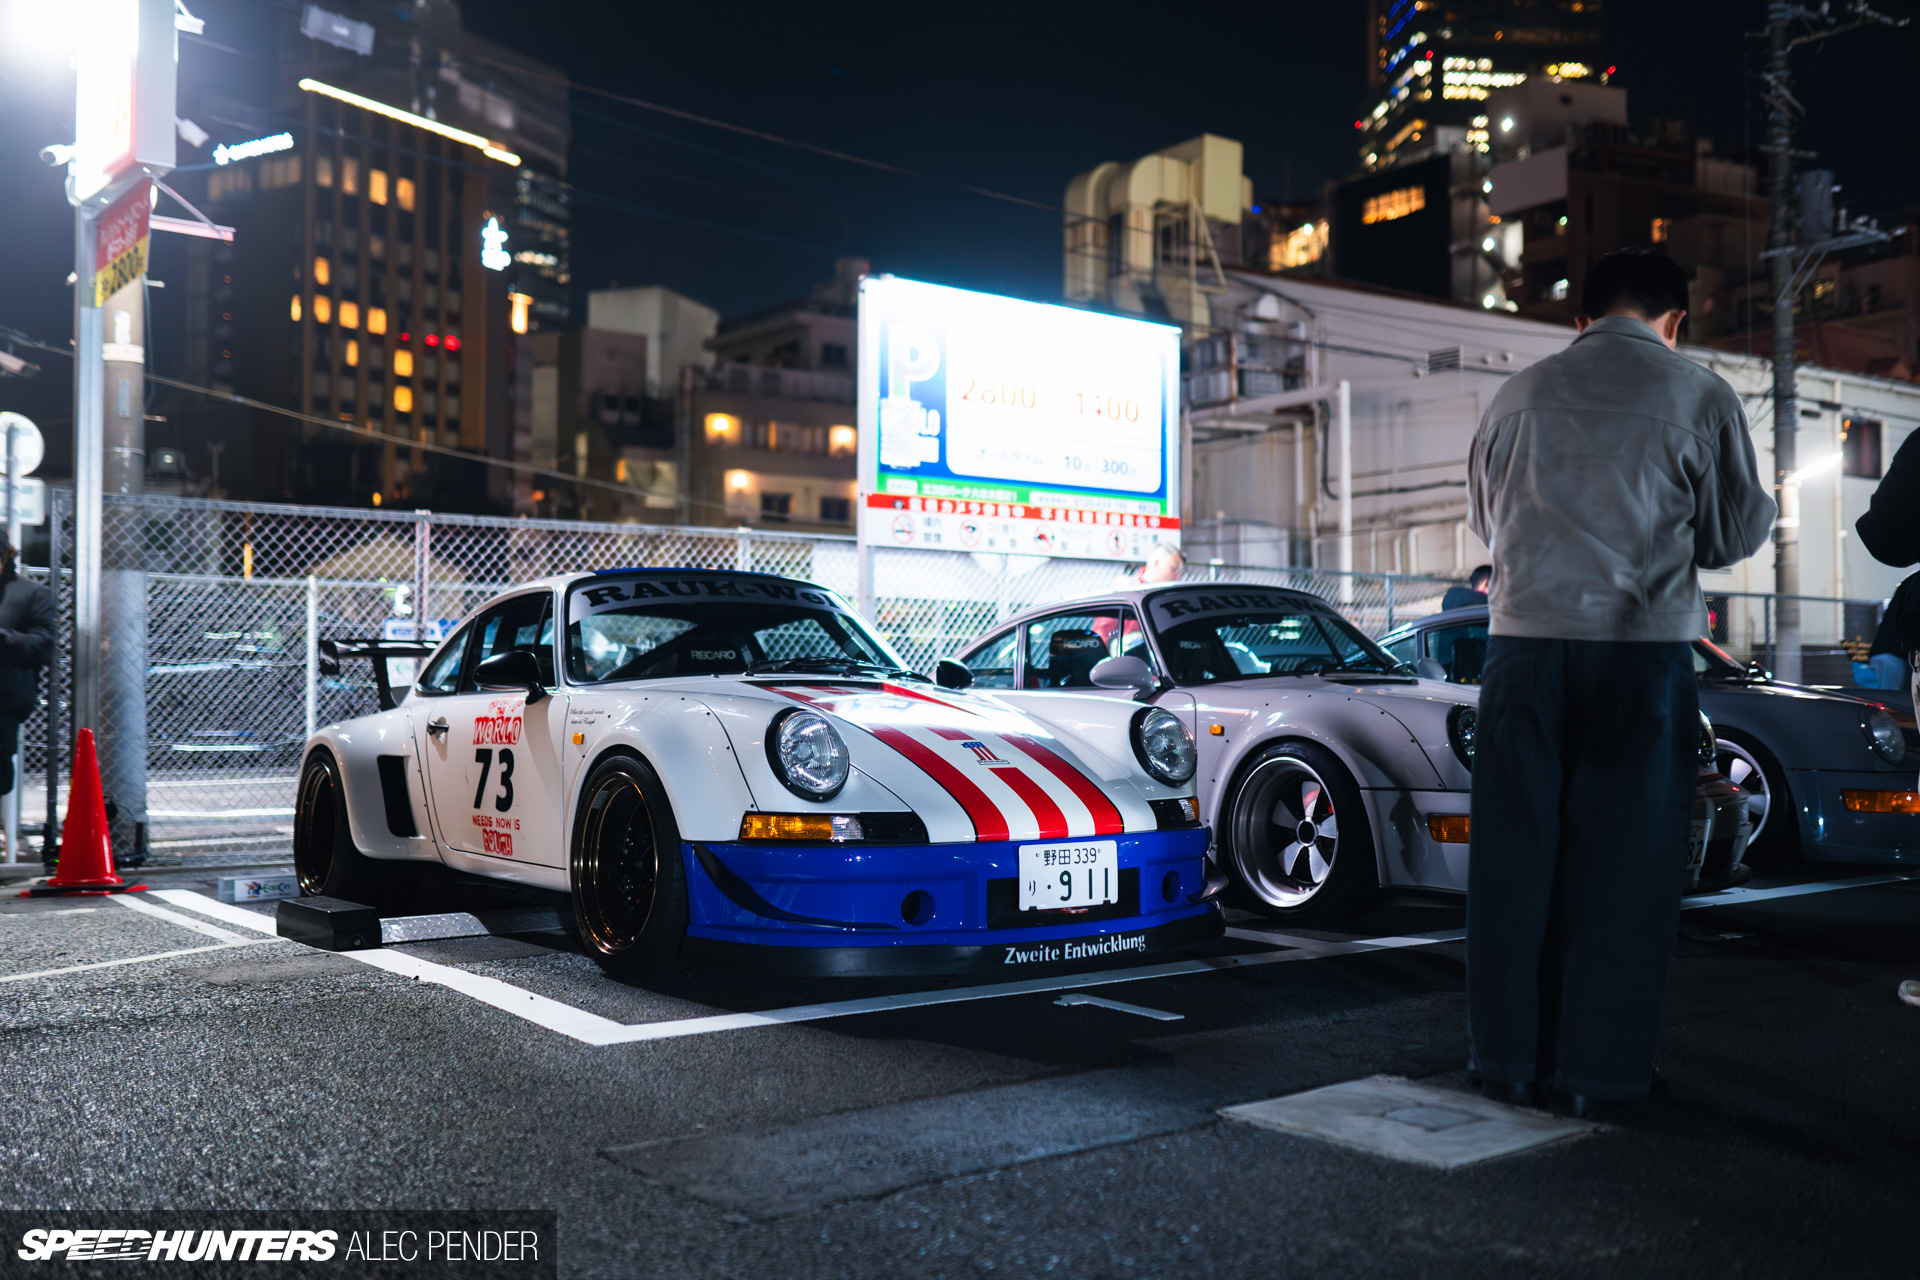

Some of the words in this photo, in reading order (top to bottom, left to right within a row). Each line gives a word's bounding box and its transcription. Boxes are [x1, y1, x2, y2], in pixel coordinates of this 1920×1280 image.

[888, 324, 940, 399] P
[962, 378, 1036, 409] 2800
[690, 649, 737, 661] RECARO
[472, 716, 522, 745] WORLD
[473, 748, 515, 812] 73
[472, 815, 493, 828] NEEDS
[495, 817, 511, 830] NOW
[513, 819, 521, 831] IS
[1028, 879, 1037, 897] り
[1004, 945, 1060, 964] Zweite
[1065, 935, 1146, 960] Entwicklung
